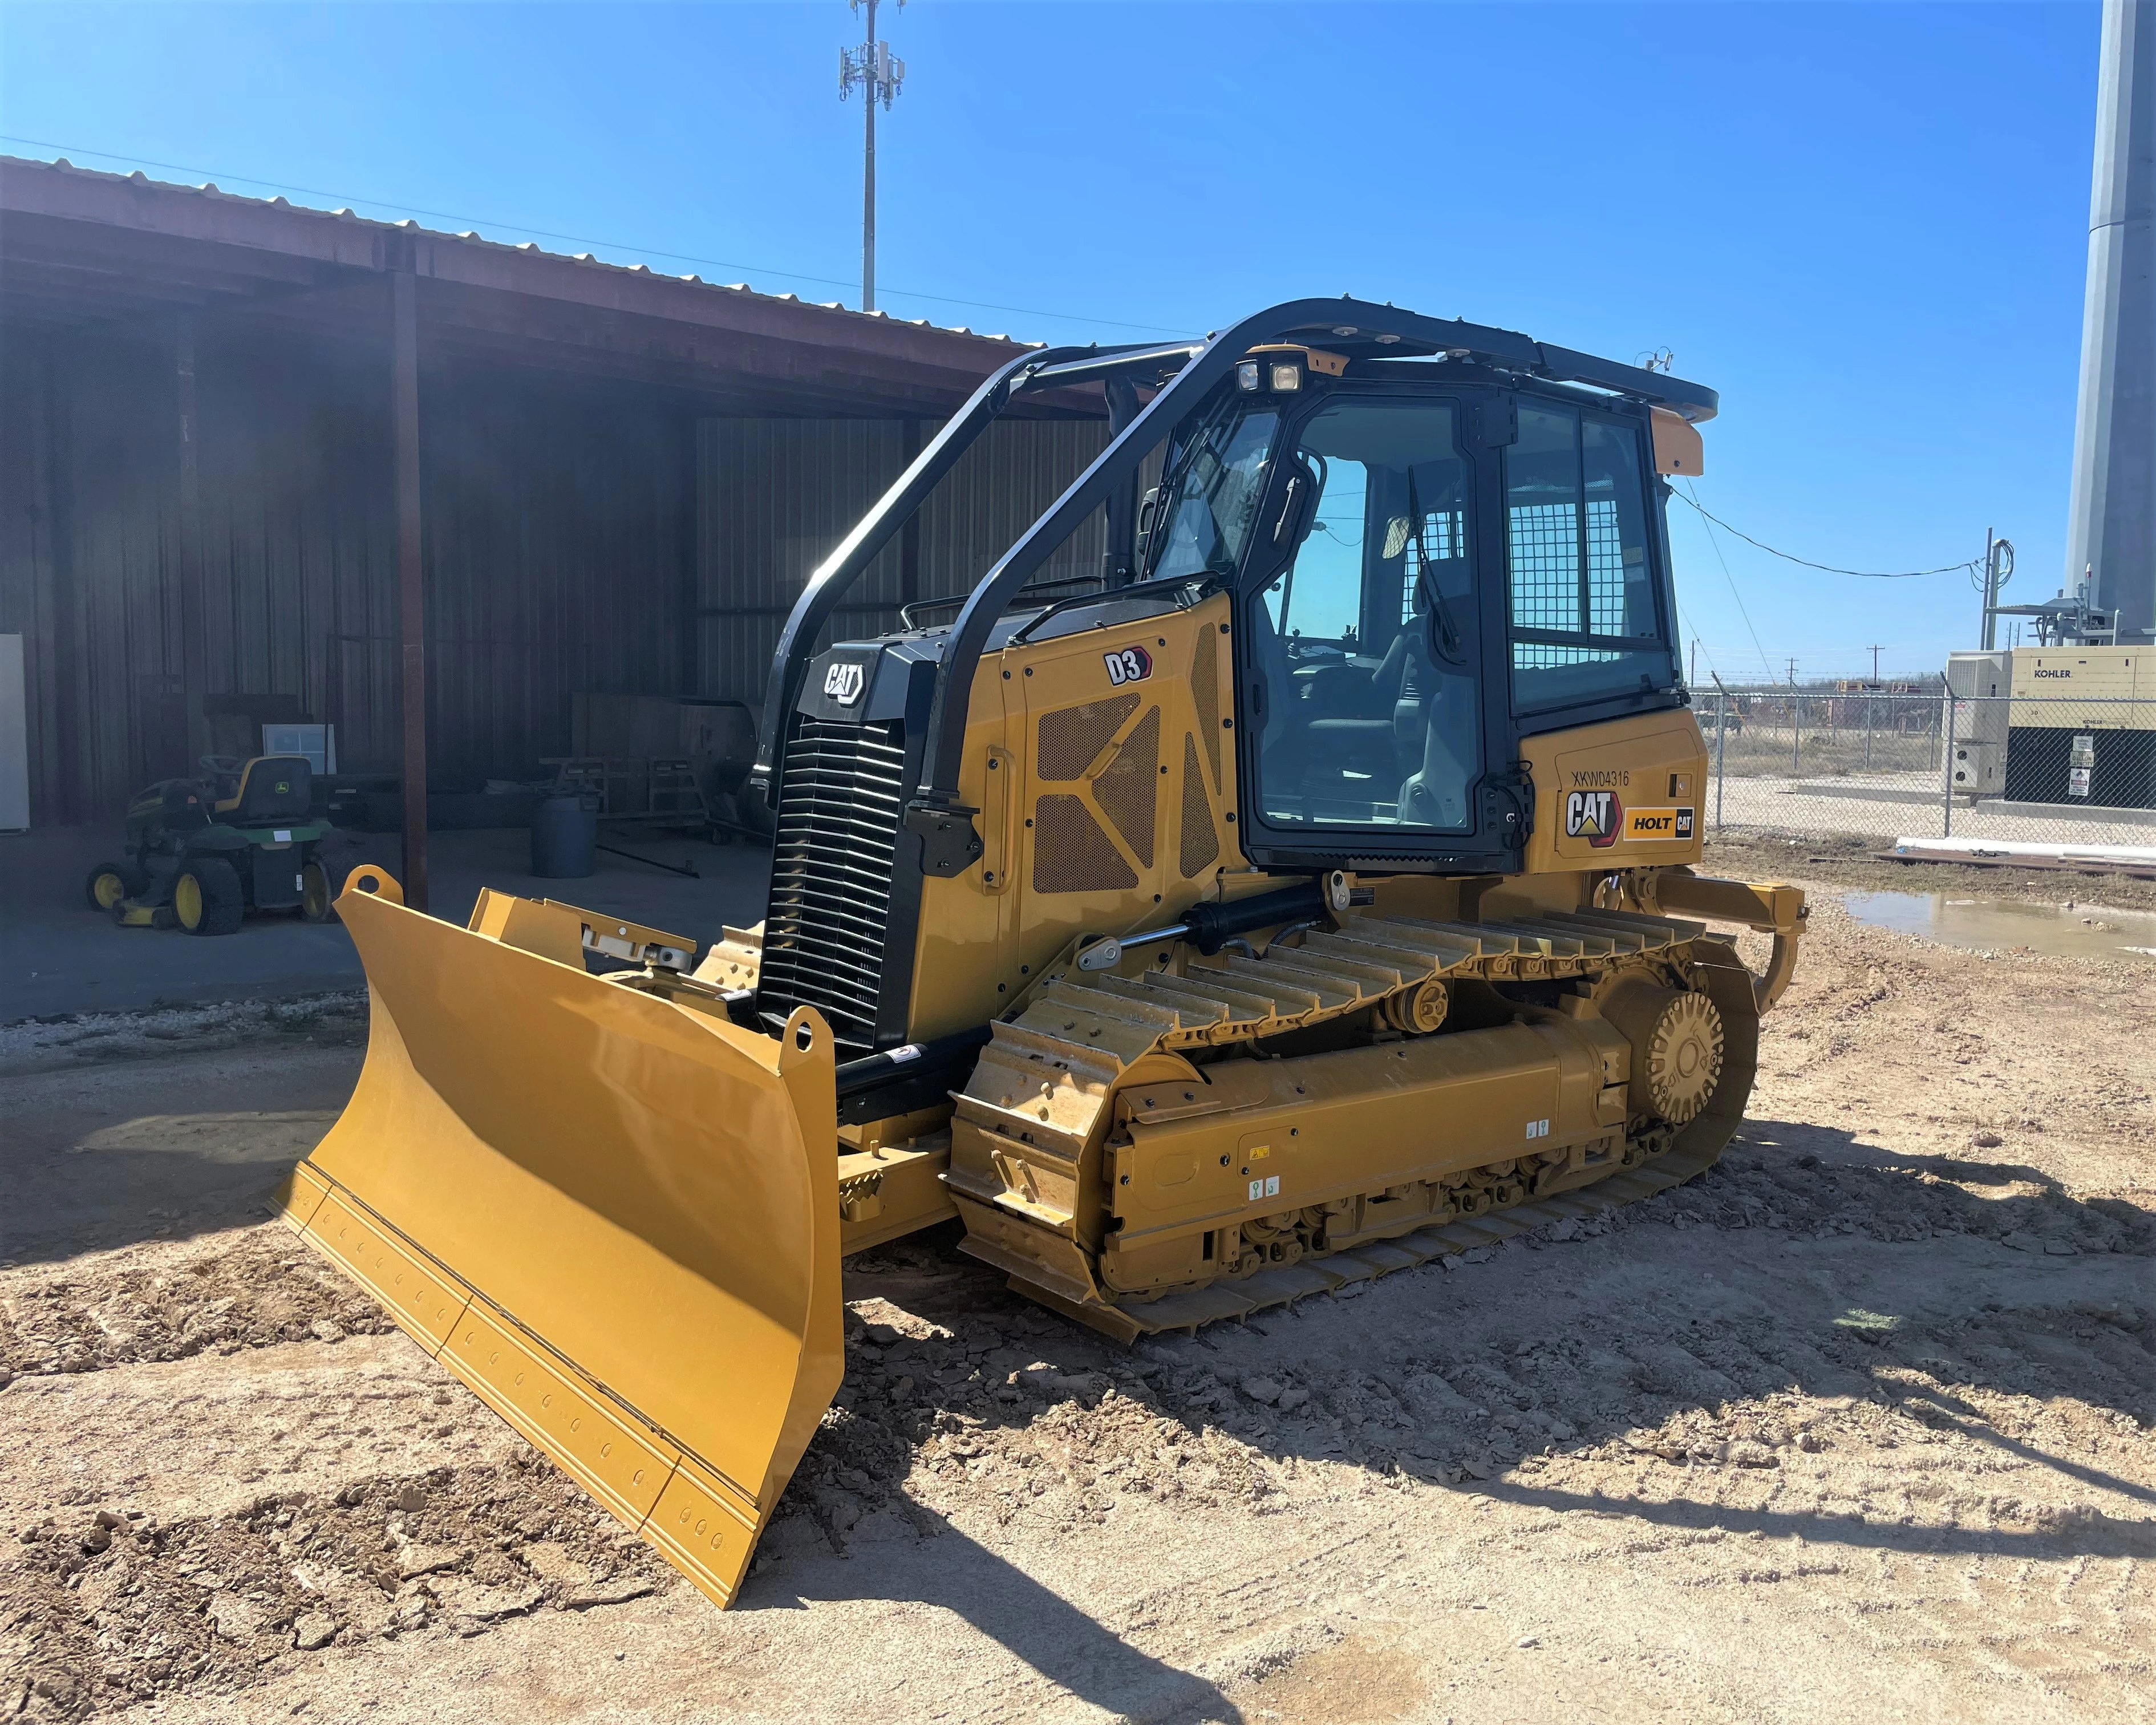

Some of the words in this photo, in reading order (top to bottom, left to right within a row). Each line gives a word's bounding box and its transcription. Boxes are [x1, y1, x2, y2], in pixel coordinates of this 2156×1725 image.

[824, 663, 858, 695] CAT
[1104, 650, 1141, 684] D3
[2034, 670, 2070, 678] KOHLER
[1571, 771, 1630, 787] XKW04316
[1568, 792, 1611, 836] CAT
[1634, 817, 1672, 830] HOLT
[1677, 816, 1692, 831] CAT
